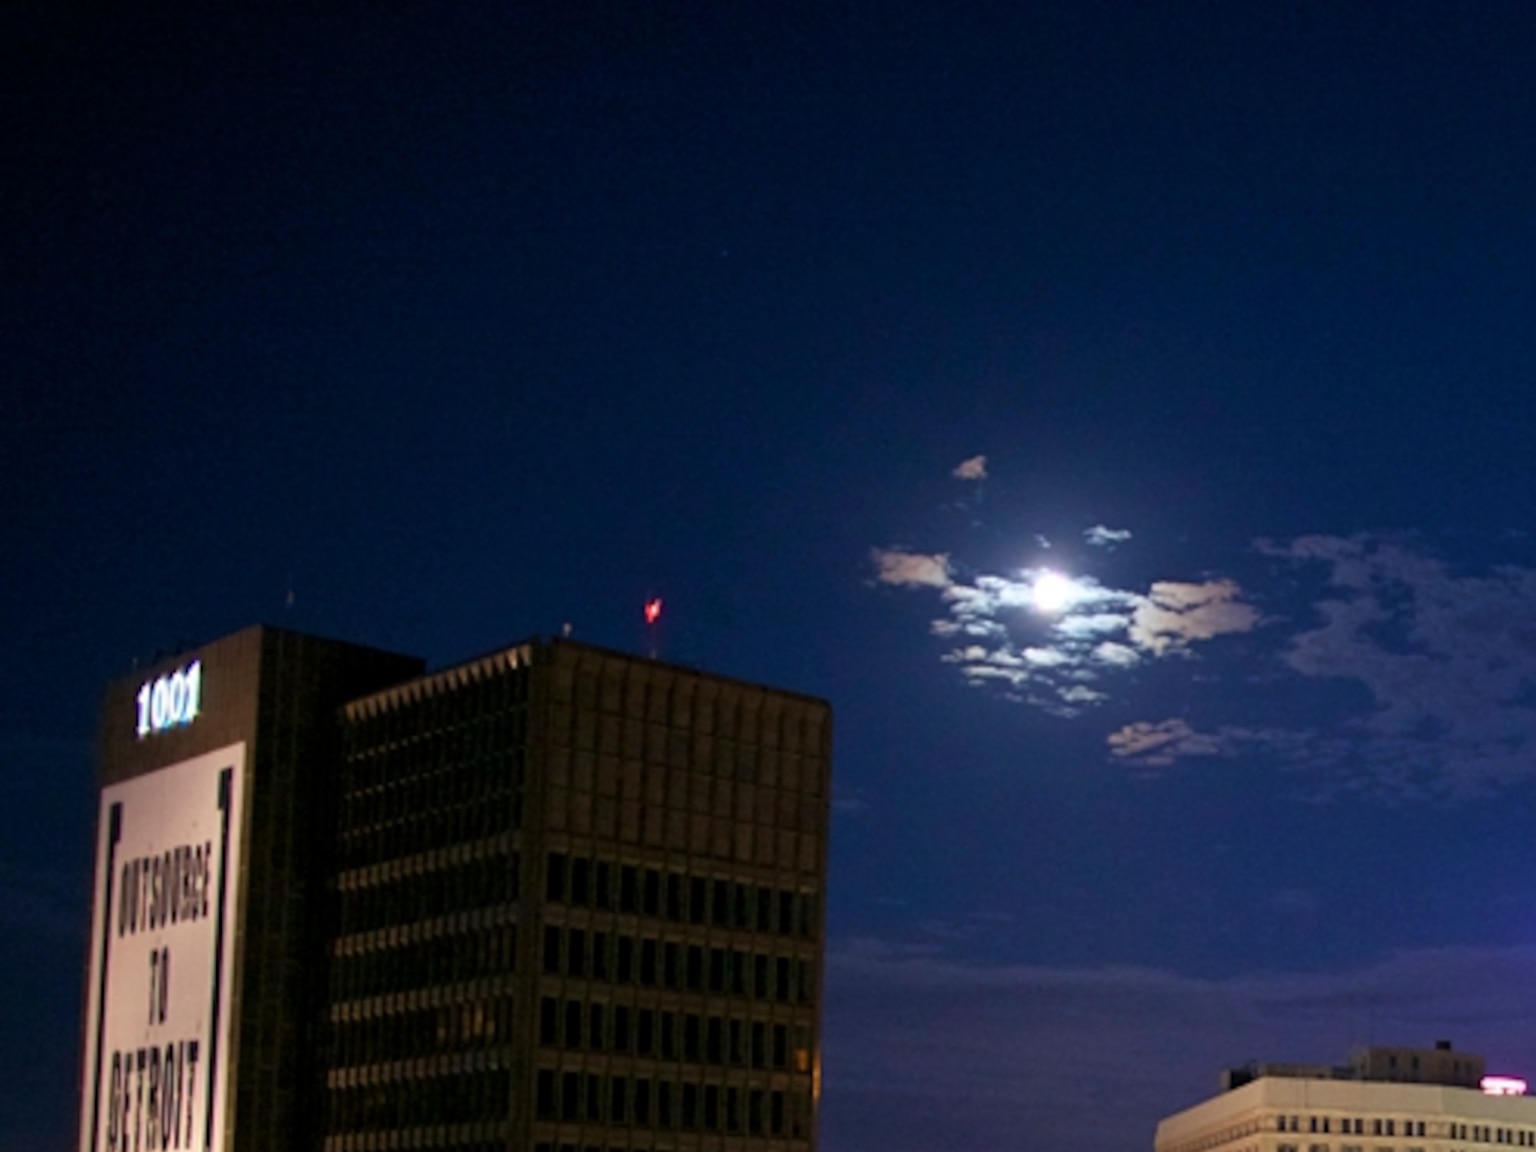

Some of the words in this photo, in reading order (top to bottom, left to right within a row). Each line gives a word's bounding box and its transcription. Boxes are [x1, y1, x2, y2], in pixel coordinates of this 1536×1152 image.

[138, 660, 201, 737] 1001
[117, 839, 211, 937] OUTSOURCE
[149, 947, 169, 1026] TO
